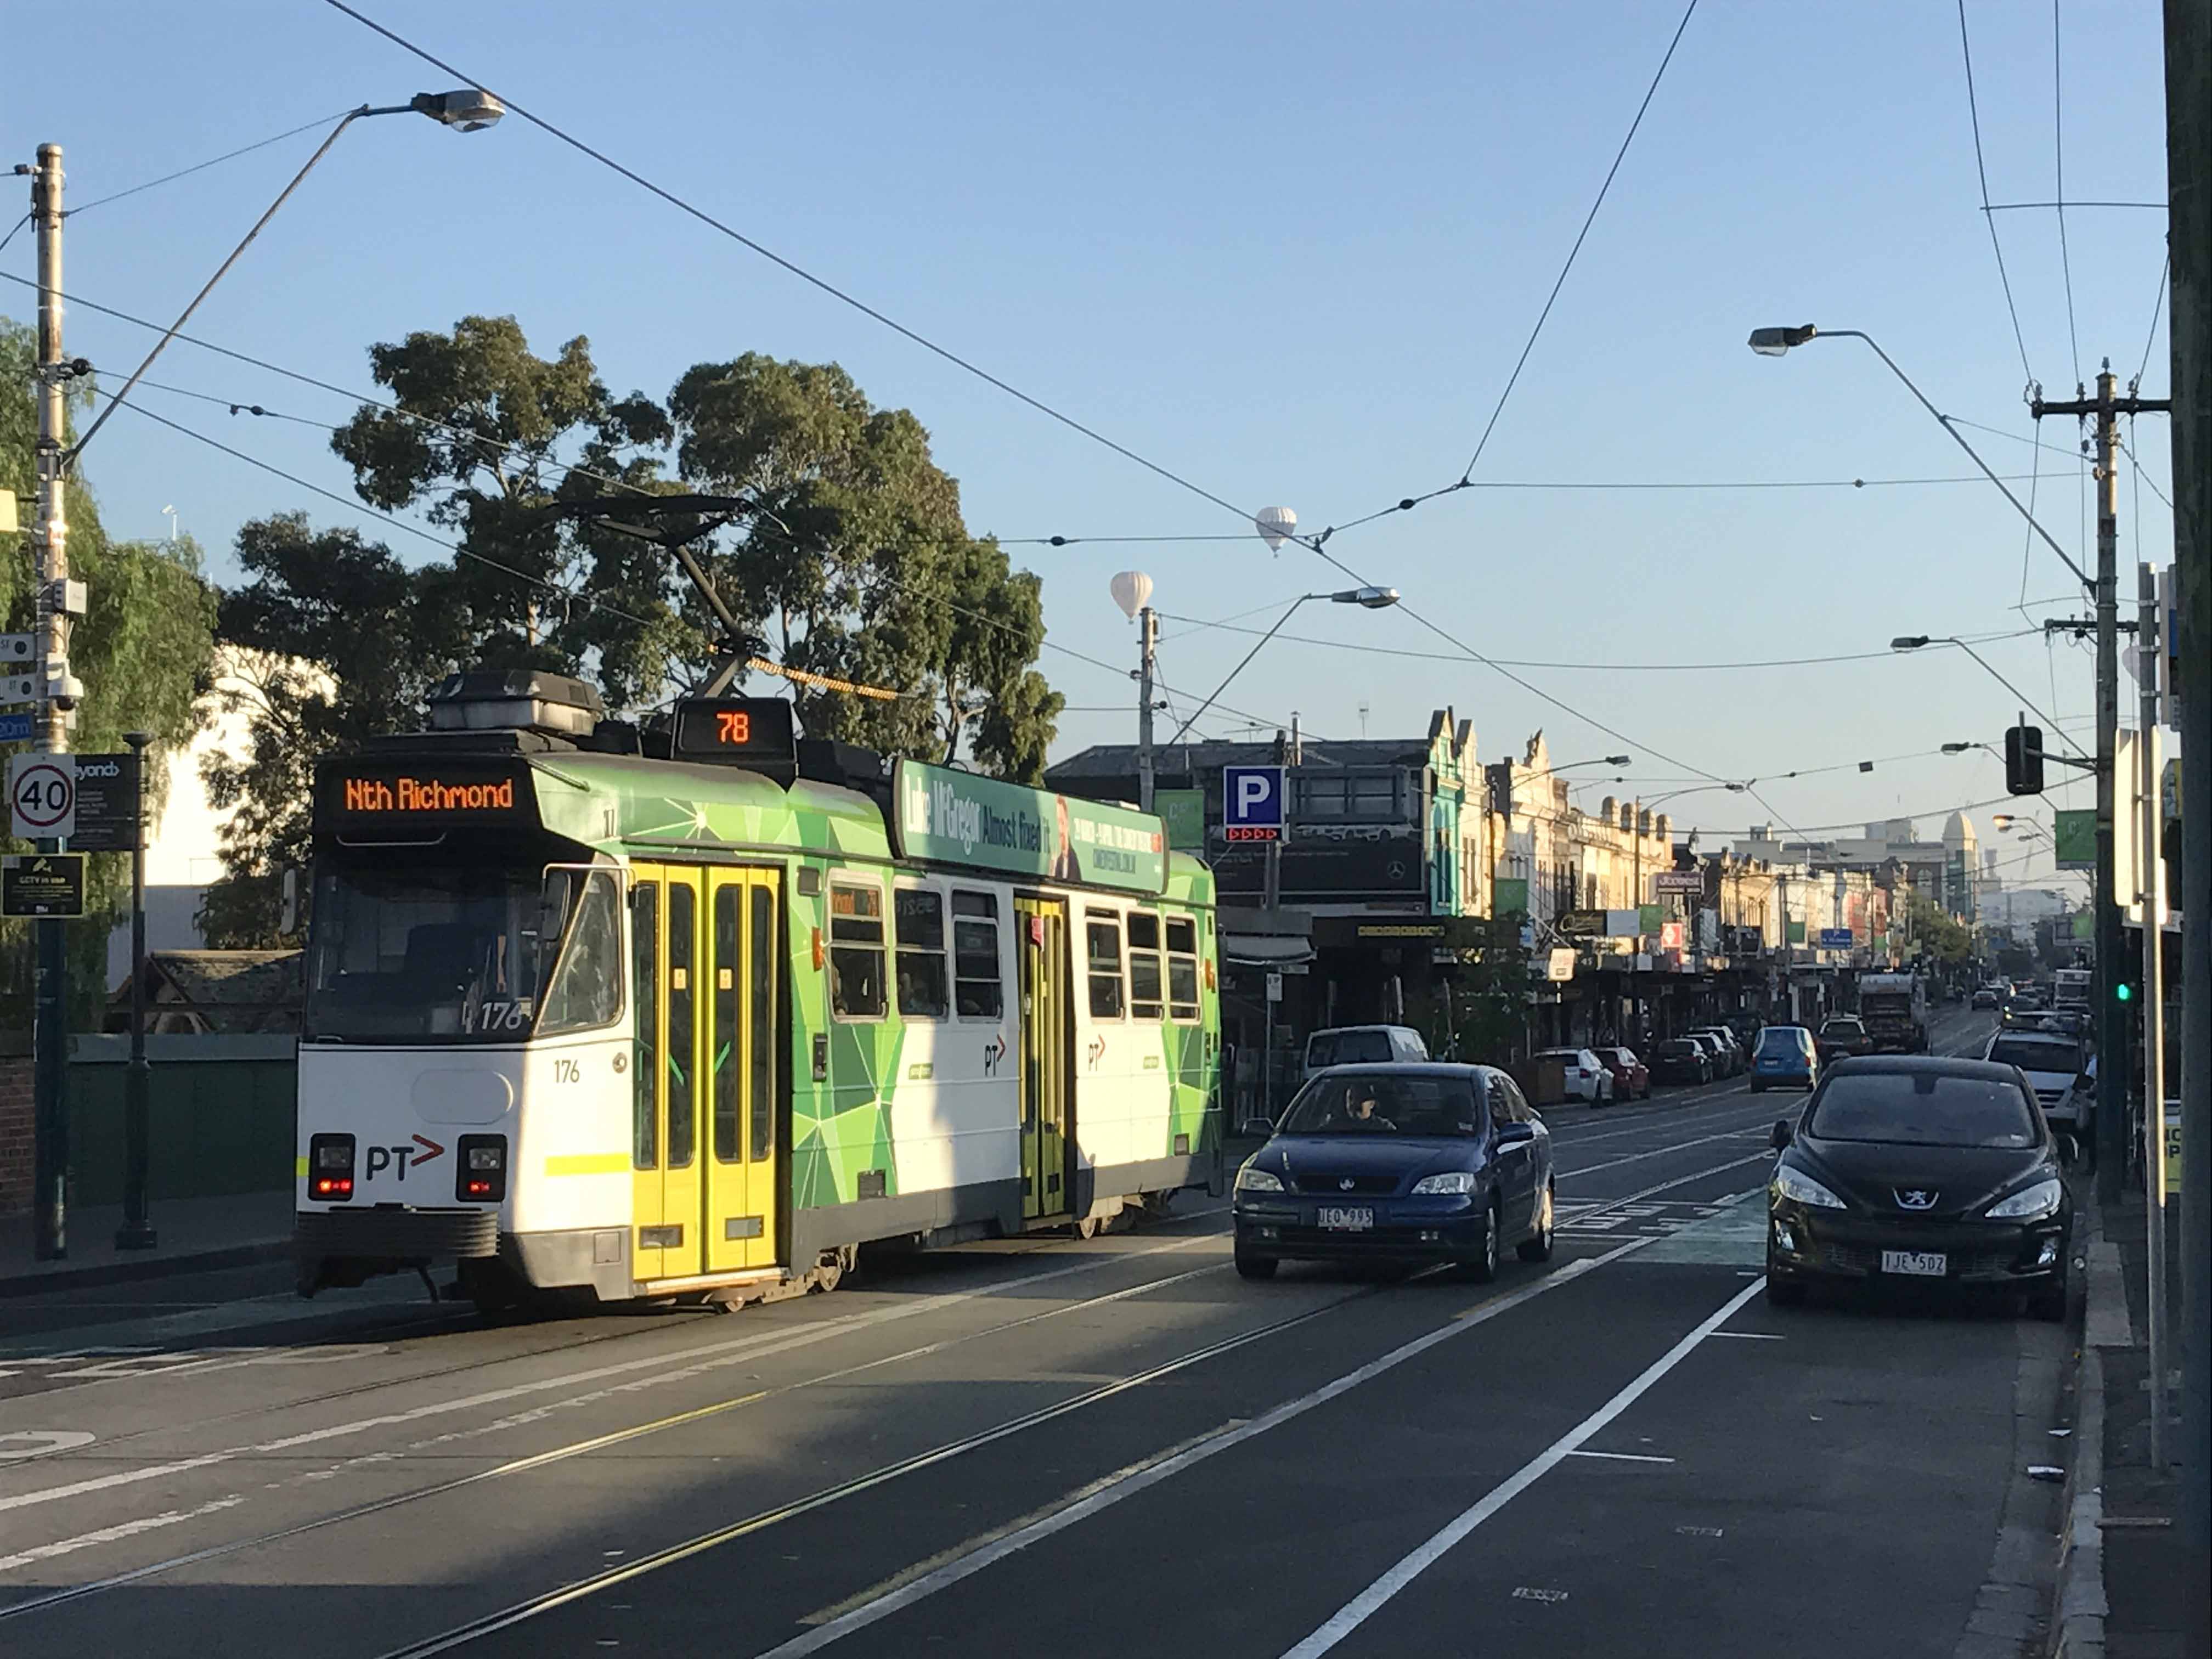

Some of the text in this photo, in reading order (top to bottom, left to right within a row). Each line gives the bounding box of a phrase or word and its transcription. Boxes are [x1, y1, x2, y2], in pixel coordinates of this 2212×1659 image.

[716, 714, 748, 742] 78
[20, 781, 66, 810] 40
[346, 778, 513, 810] Nth Richmond
[1238, 775, 1270, 818] P
[905, 774, 932, 834] Luke
[983, 805, 1017, 849] Almost
[19, 876, 39, 884] CCTV
[481, 1002, 521, 1030] 176
[554, 1059, 580, 1084] 176
